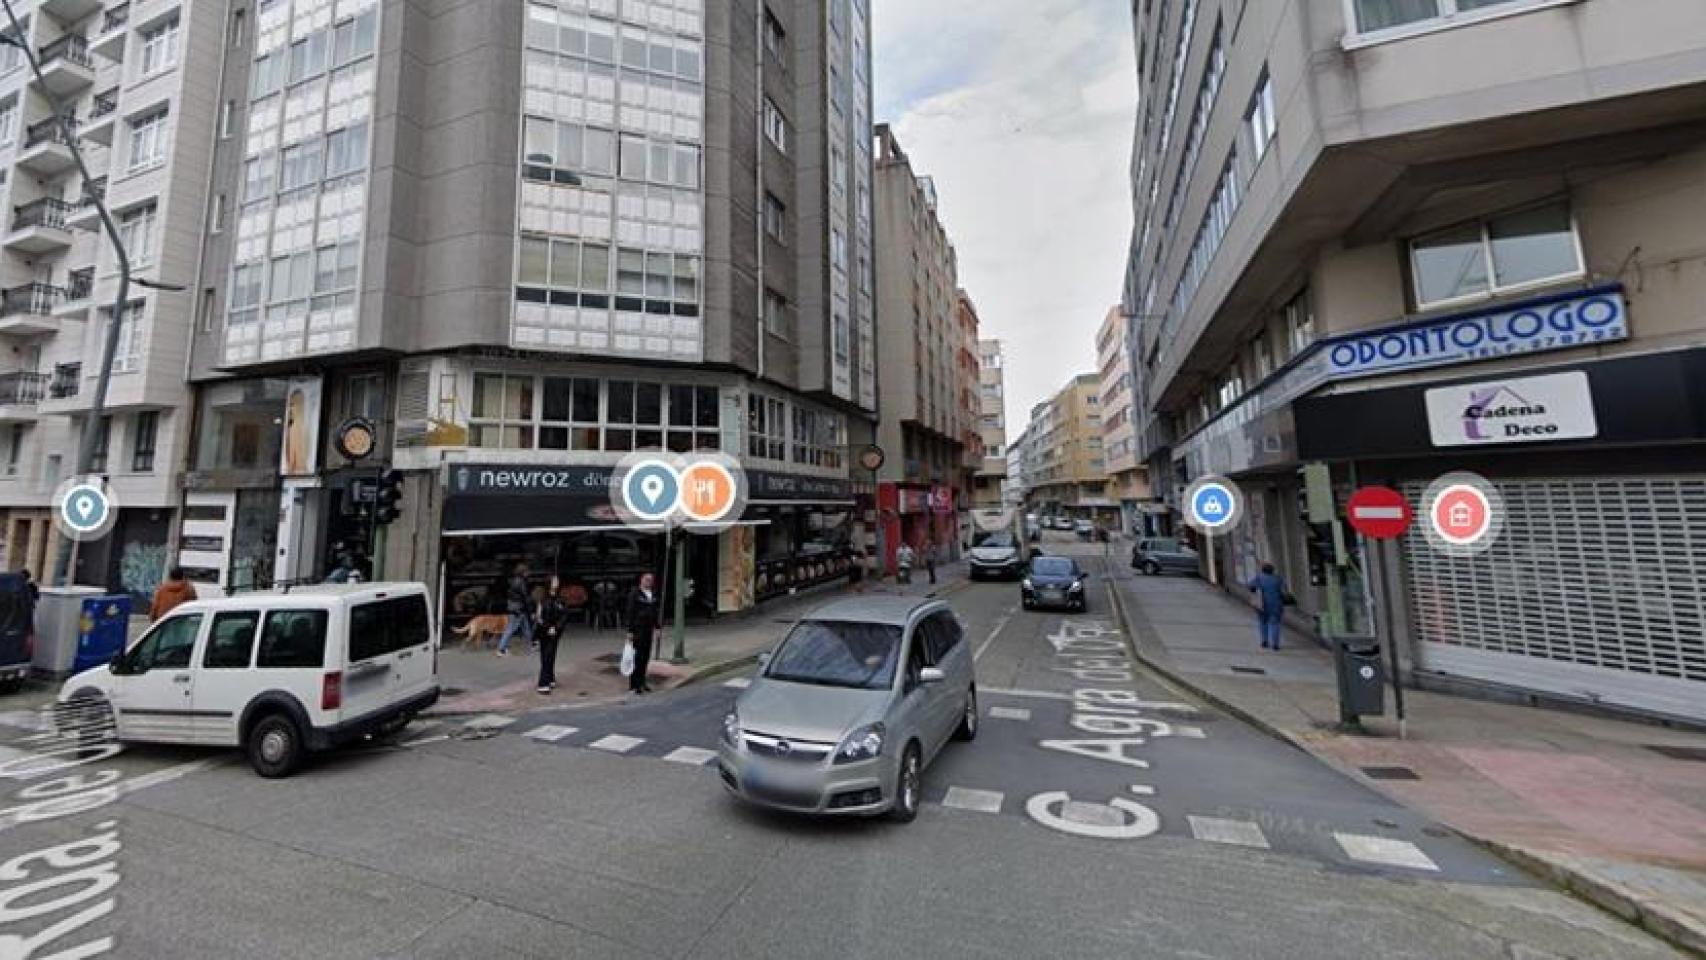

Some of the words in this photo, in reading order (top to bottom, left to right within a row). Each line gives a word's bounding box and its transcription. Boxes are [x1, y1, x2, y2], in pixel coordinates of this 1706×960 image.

[1331, 298, 1618, 367] ODONTOLOGO
[1462, 403, 1546, 419] Cadena
[1503, 422, 1559, 437] Deco
[480, 469, 570, 488] newroz
